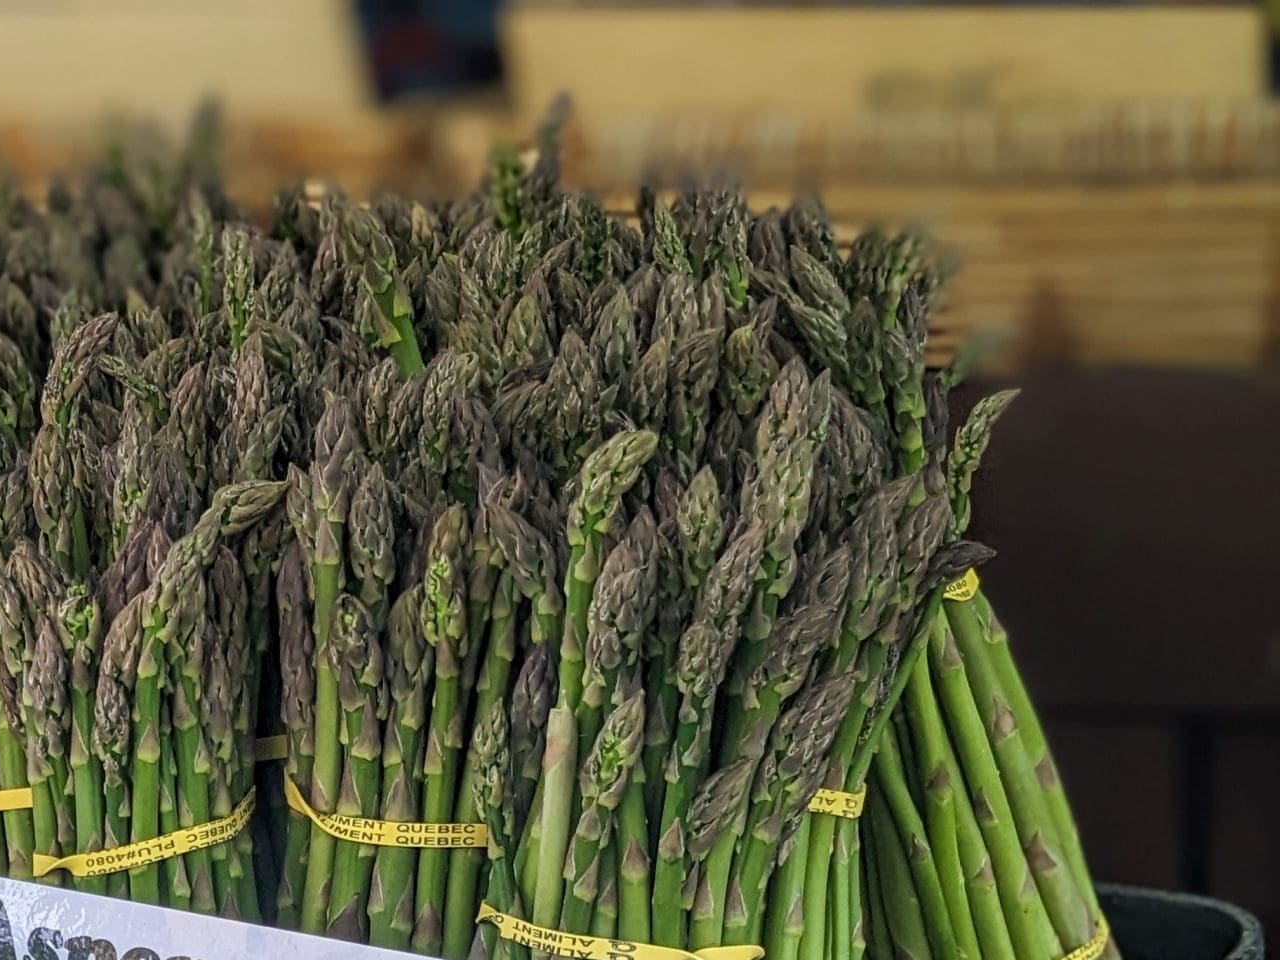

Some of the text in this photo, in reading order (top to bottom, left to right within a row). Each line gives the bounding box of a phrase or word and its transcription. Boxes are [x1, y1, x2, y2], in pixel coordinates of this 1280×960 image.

[397, 824, 476, 835] QUEBEC
[396, 835, 475, 846] QUEBEC
[85, 840, 175, 867] PLU#4080
